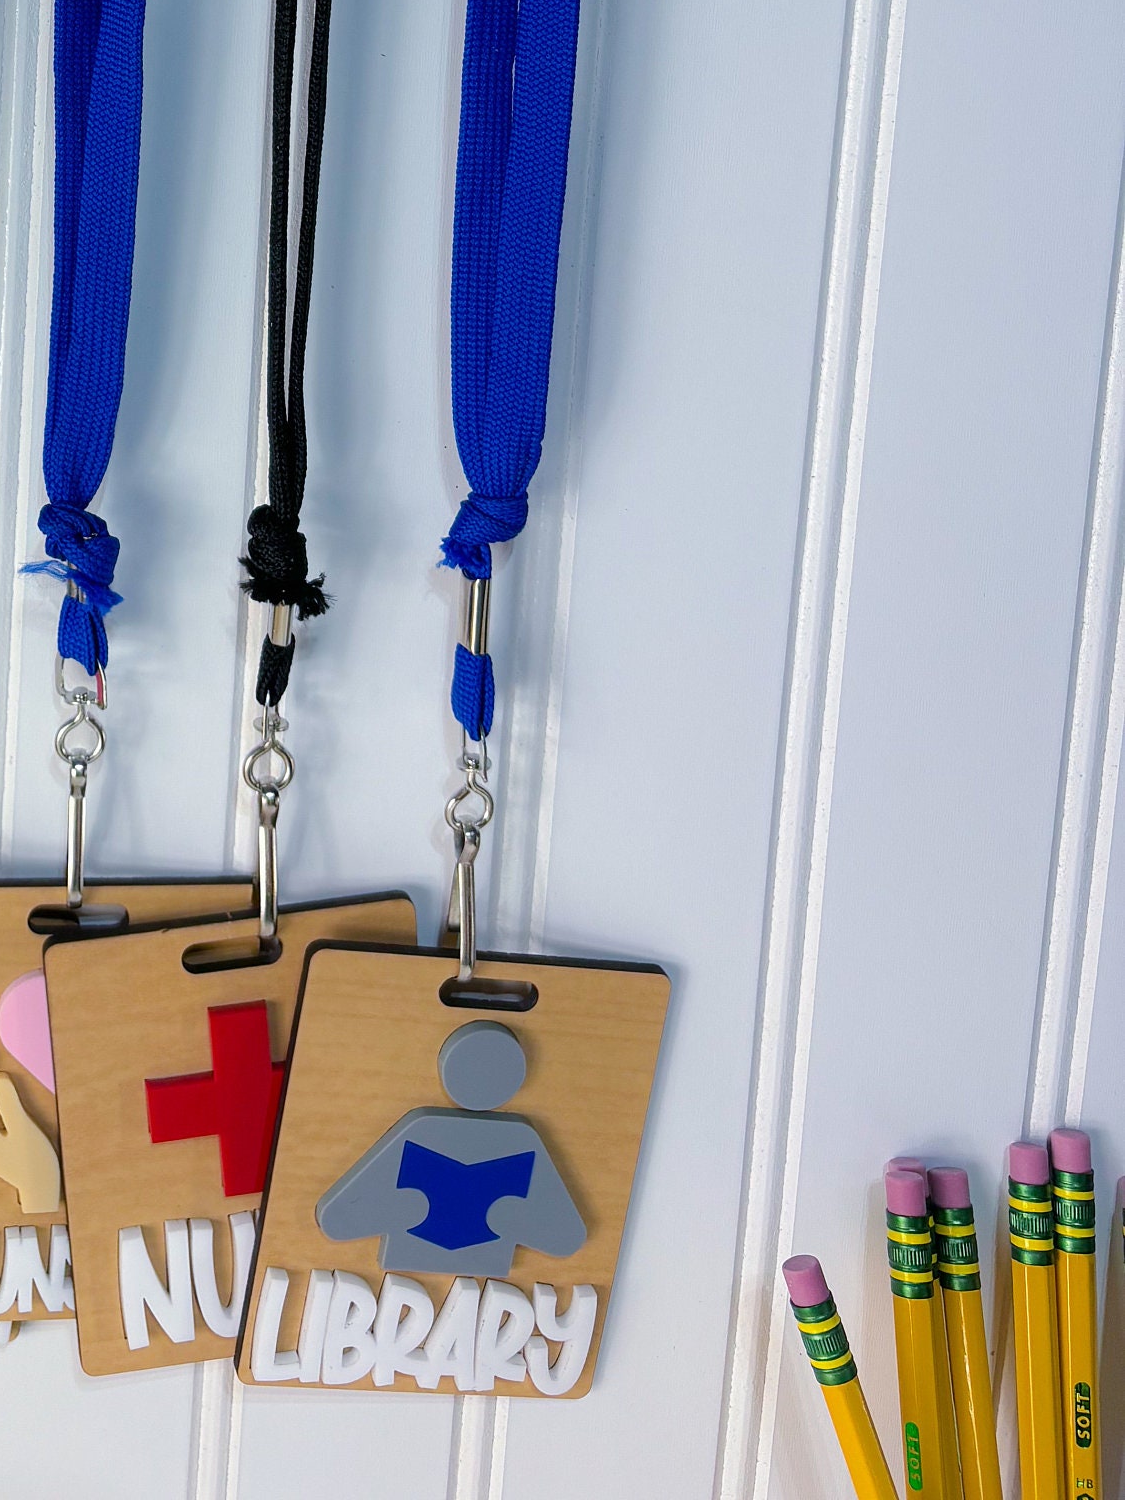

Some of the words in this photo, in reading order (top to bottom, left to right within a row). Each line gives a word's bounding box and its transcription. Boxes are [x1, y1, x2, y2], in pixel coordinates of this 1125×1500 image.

[118, 1208, 260, 1351] NU
[250, 1266, 597, 1396] LIBRARY
[1077, 1393, 1090, 1439] SOFT
[1076, 1478, 1093, 1489] HB
